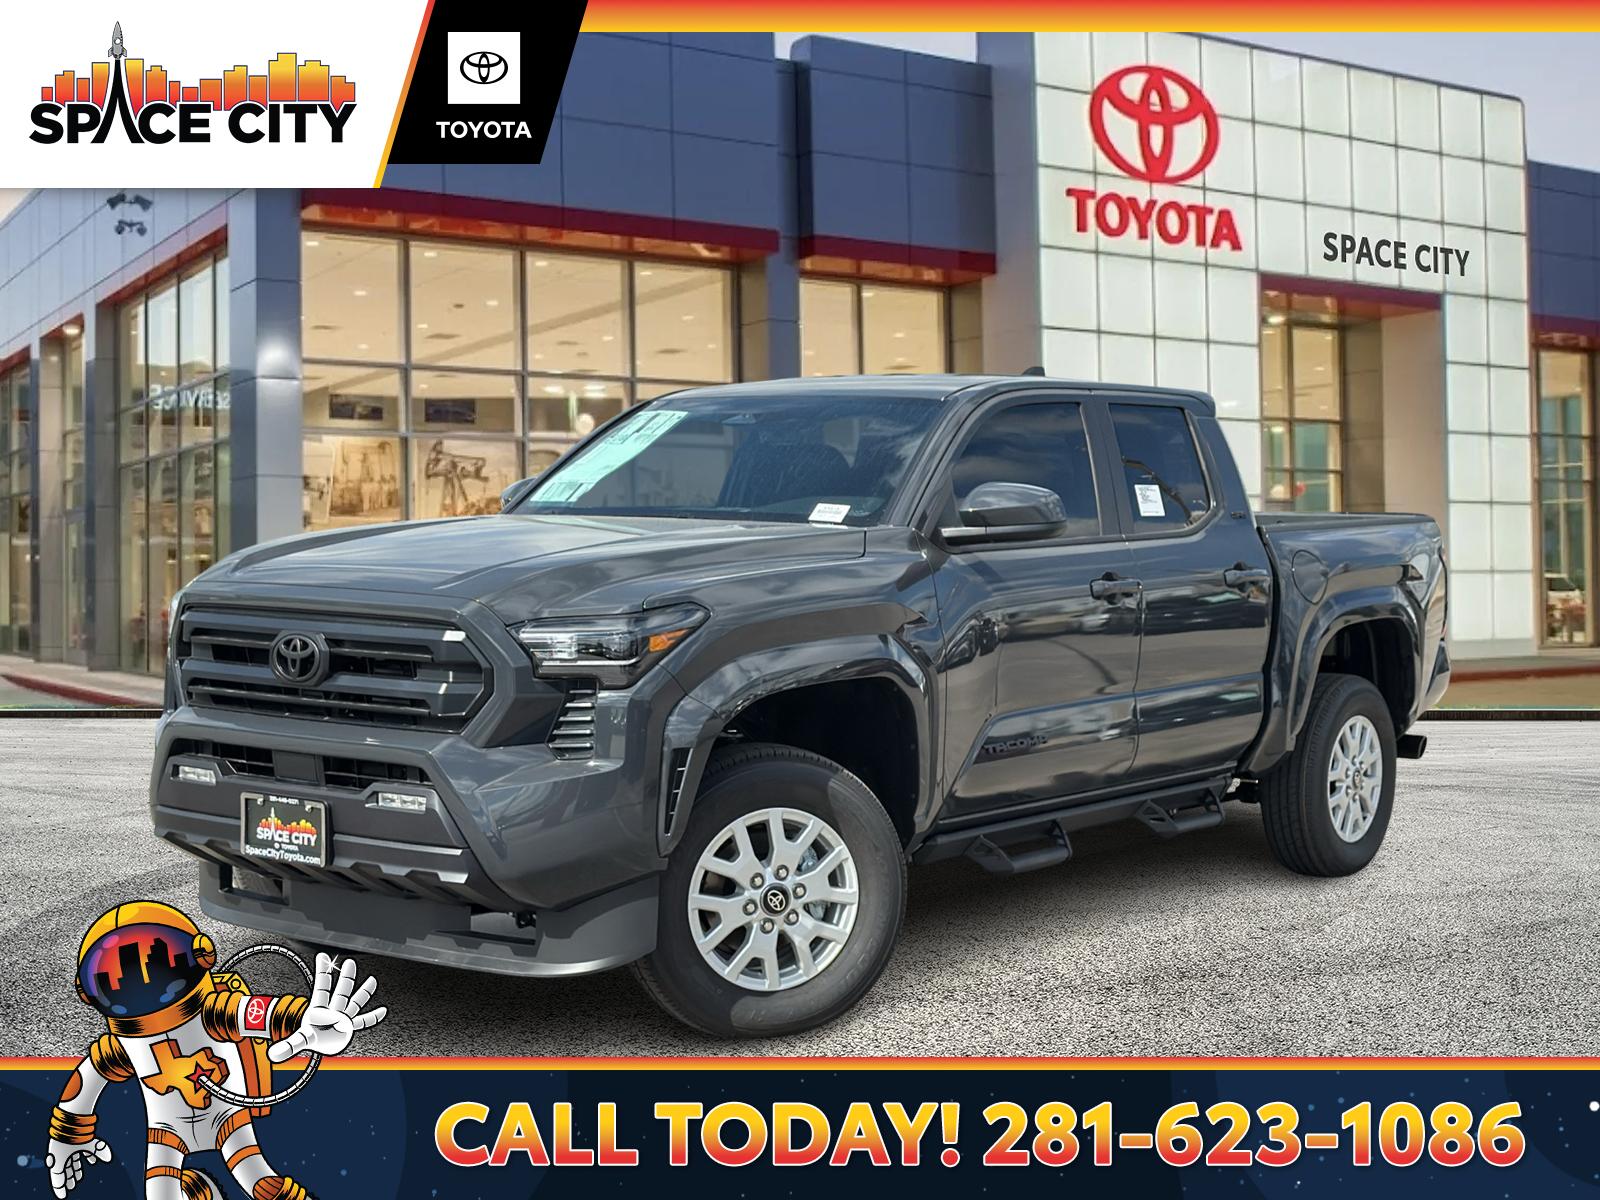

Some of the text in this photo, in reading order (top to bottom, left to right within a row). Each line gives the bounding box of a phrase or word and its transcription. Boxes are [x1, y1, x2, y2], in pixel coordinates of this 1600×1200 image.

[1066, 187, 1242, 251] TOYOTA
[1323, 231, 1470, 277] SPACE CITY
[256, 820, 317, 847] SPACE CITY
[245, 844, 321, 865] SpaceCityToyota.com
